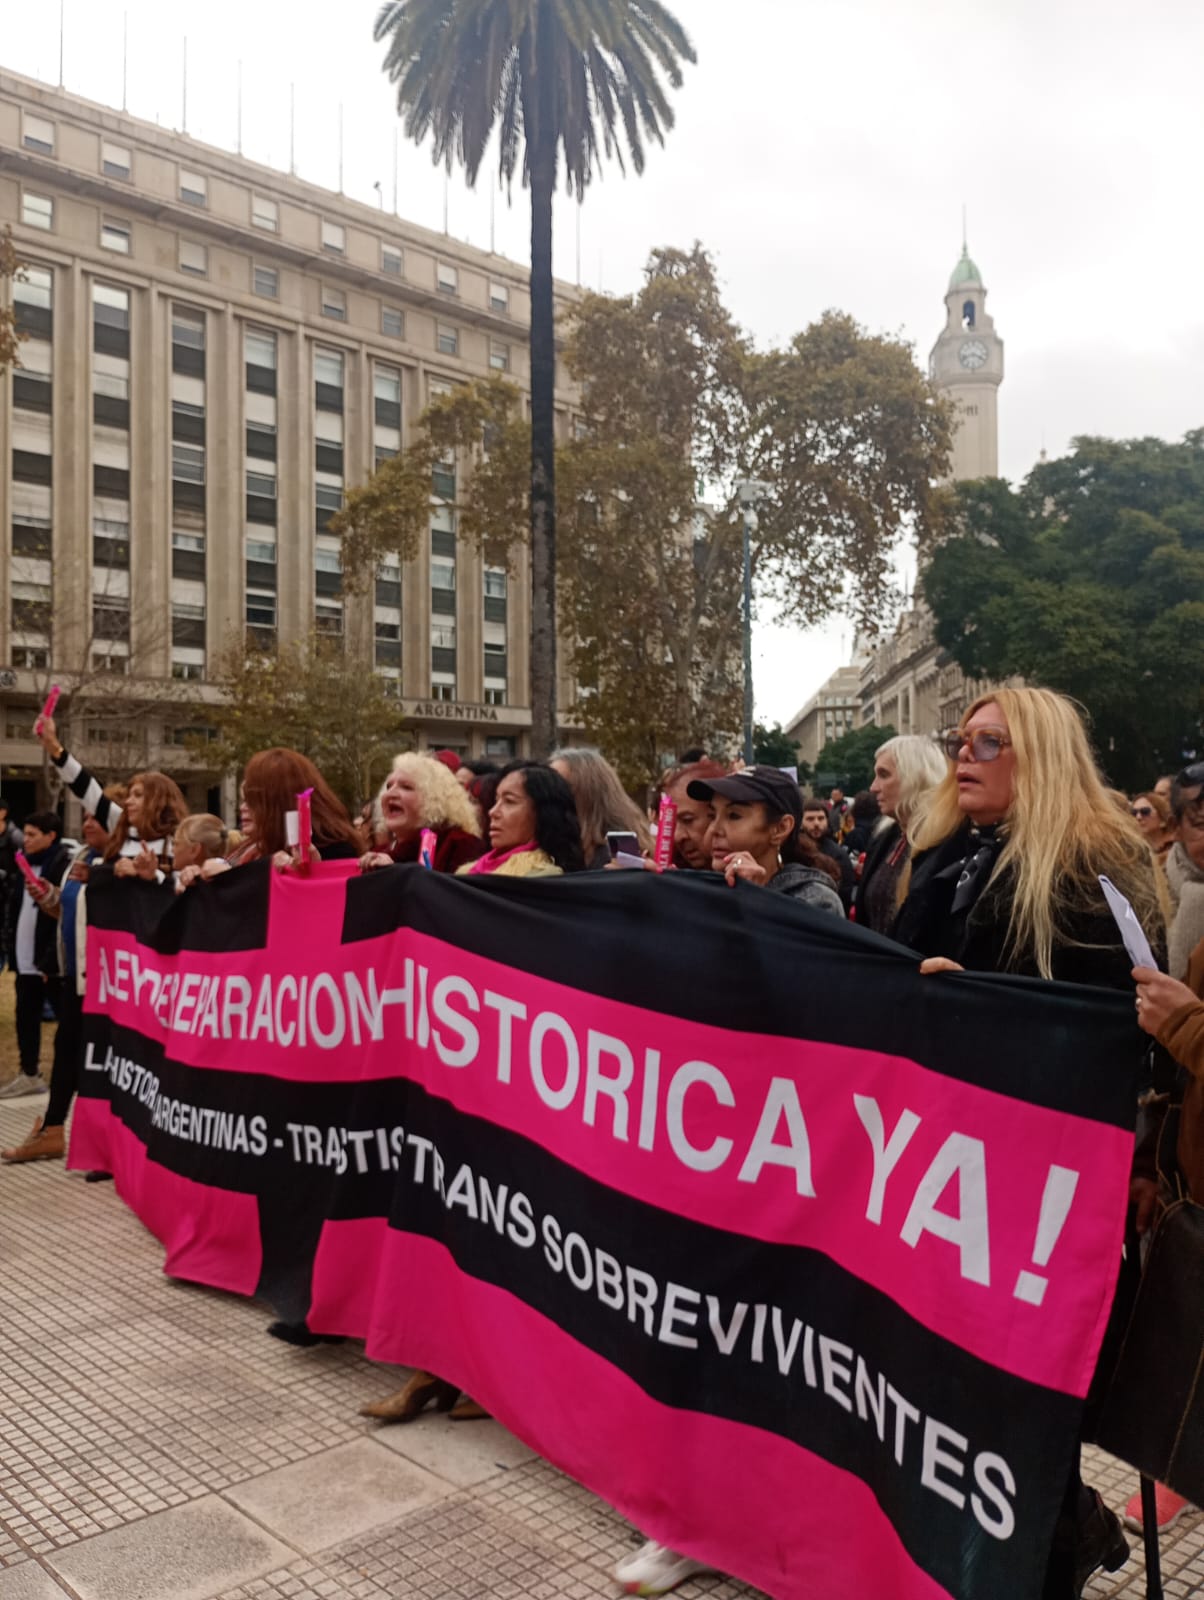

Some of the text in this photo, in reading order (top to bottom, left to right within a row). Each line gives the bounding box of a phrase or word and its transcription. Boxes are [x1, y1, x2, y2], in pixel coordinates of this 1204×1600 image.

[414, 704, 499, 720] ARGENTINA
[372, 957, 816, 1198] HISTORICA
[152, 1093, 268, 1156] ARGENTINAS
[407, 1133, 536, 1247] TRANS
[542, 1214, 1017, 1540] SOBREVIVIENTES
